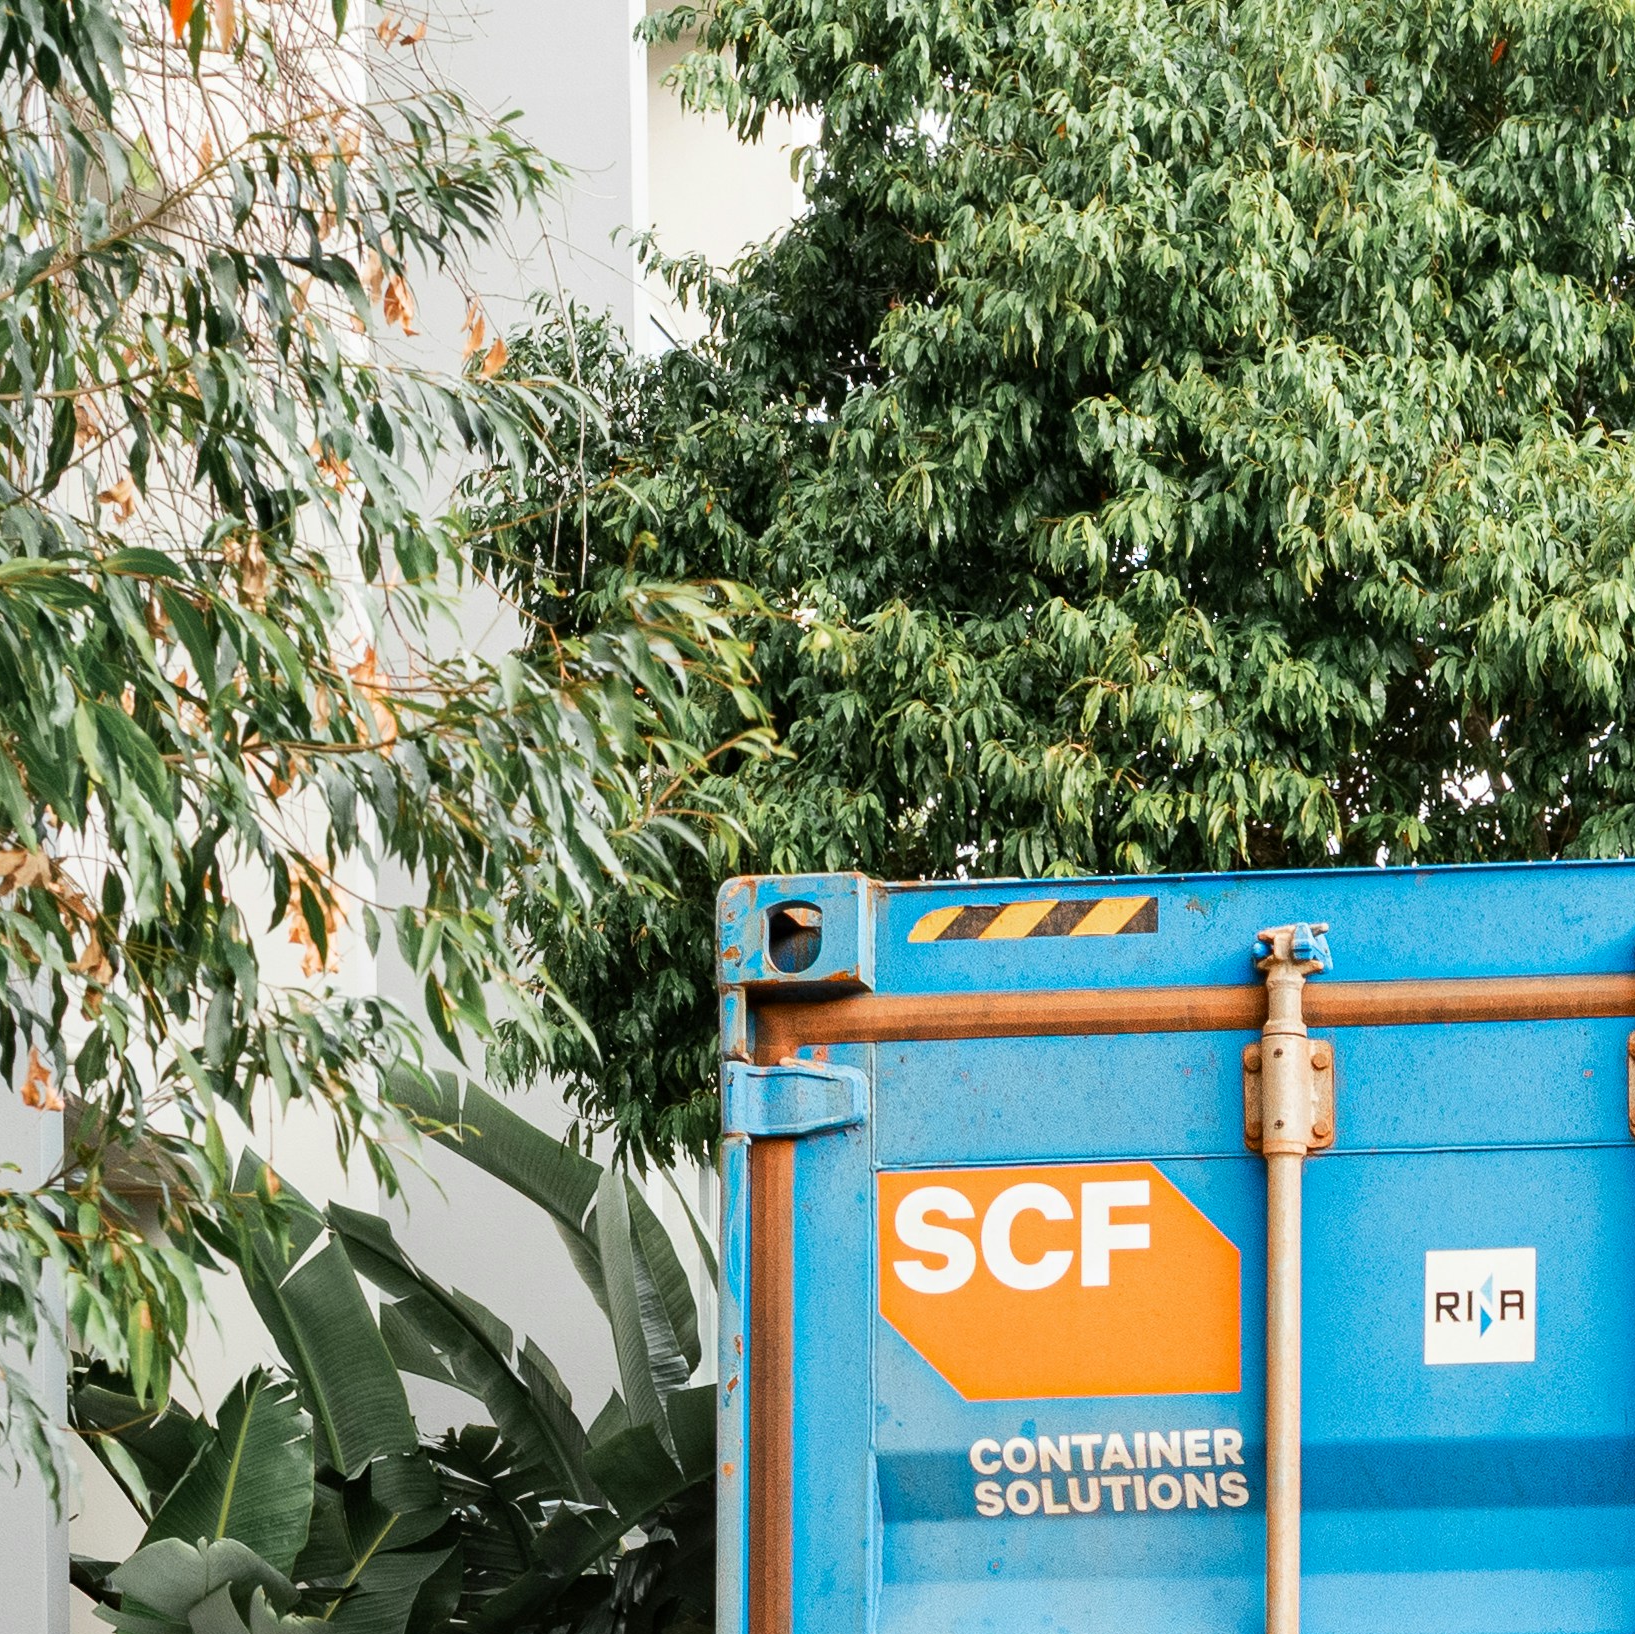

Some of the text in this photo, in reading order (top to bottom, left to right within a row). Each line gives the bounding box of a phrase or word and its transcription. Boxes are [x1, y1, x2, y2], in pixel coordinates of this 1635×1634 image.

[893, 1180, 1151, 1295] SCF
[970, 1428, 1244, 1475] CONTAINER
[975, 1471, 1249, 1517] SOLUTIONS
